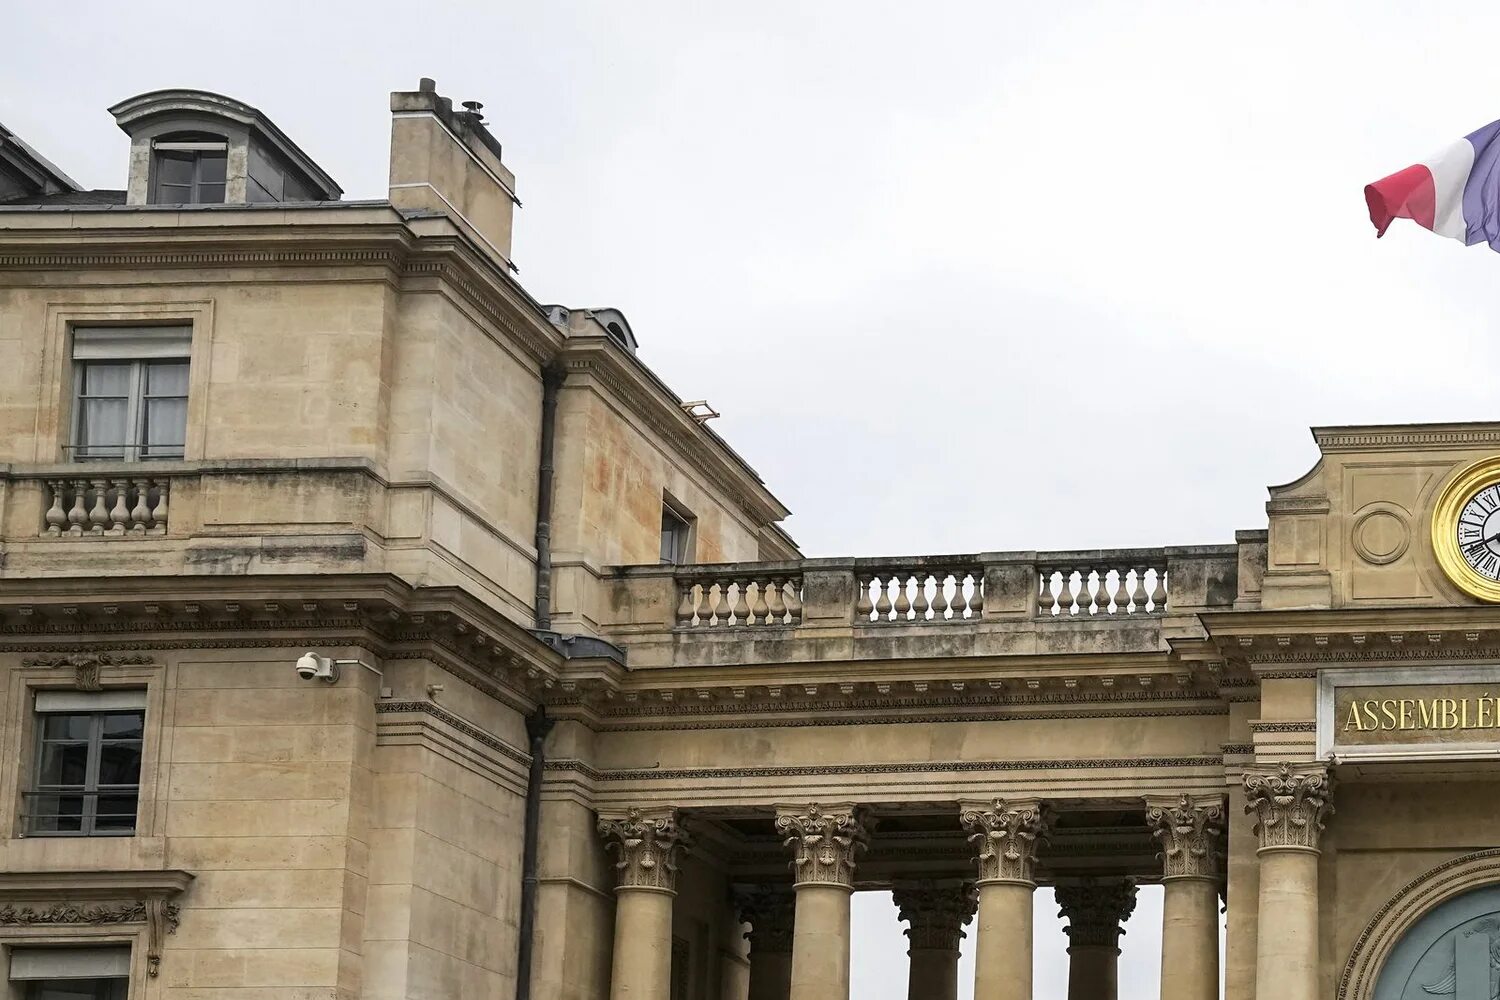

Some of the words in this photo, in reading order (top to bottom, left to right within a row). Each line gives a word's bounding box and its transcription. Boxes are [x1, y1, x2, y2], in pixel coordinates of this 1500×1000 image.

[1483, 494, 1498, 510] XI
[1469, 509, 1485, 522] X
[1464, 528, 1480, 538] IX
[1483, 555, 1498, 573] VII
